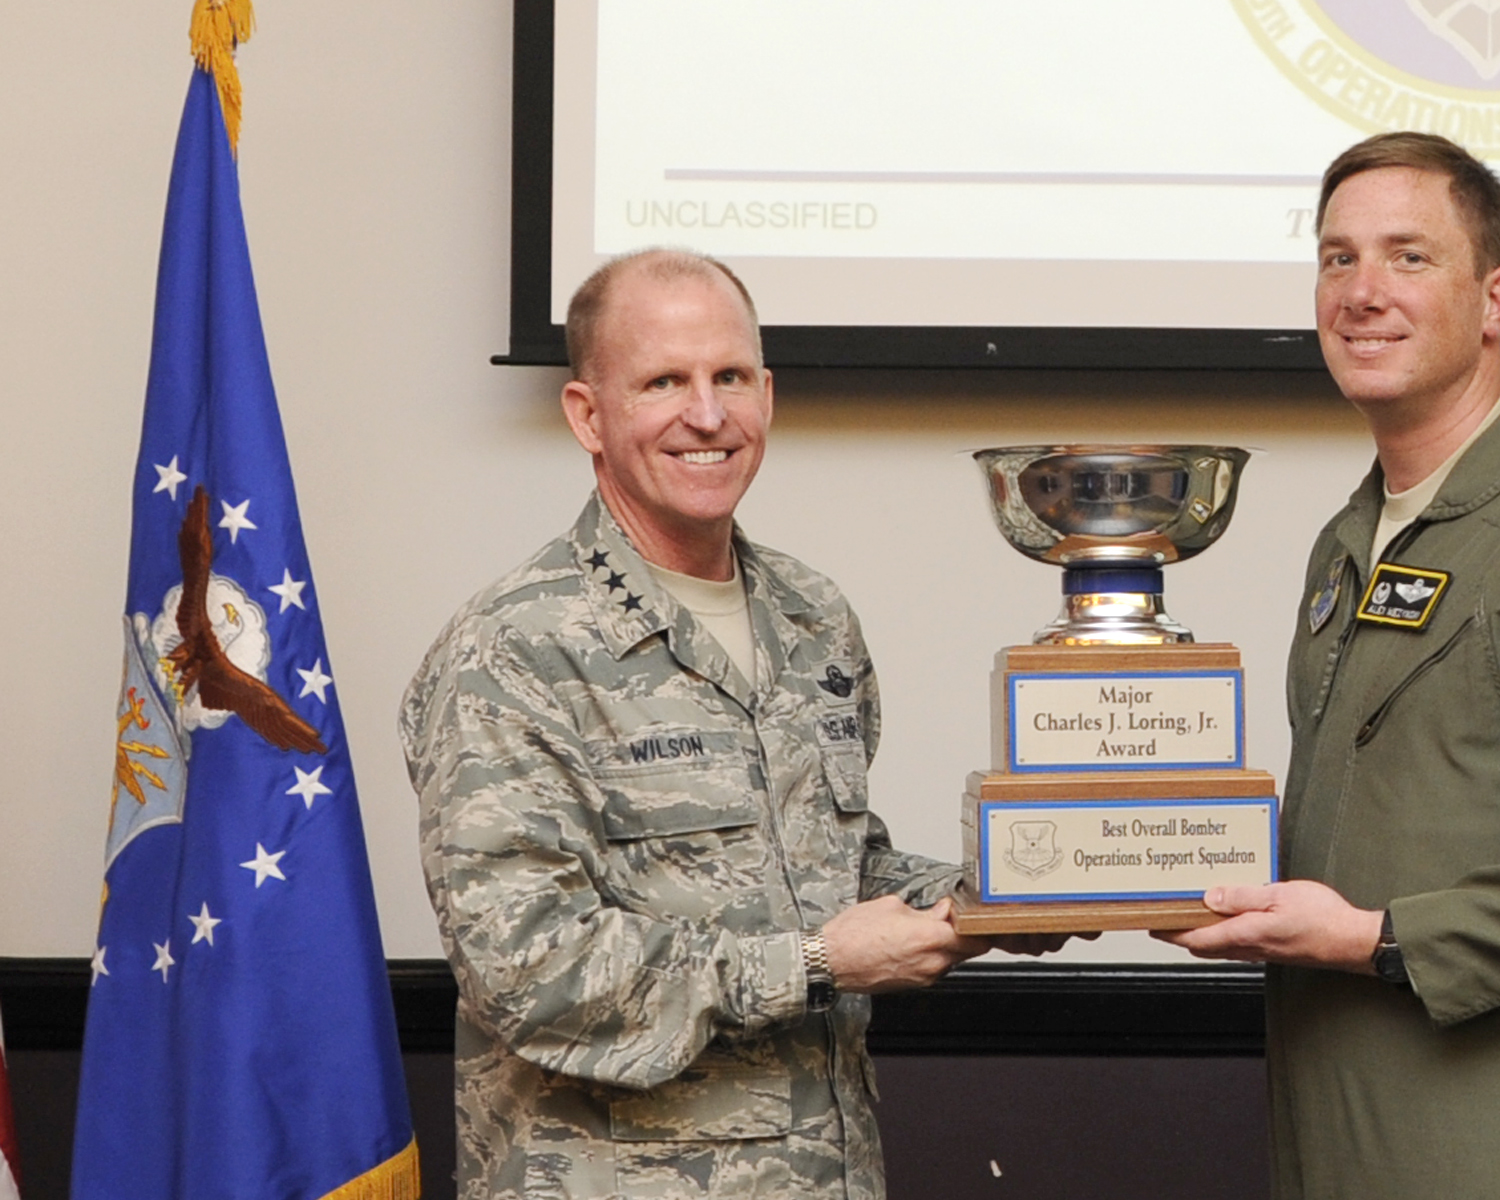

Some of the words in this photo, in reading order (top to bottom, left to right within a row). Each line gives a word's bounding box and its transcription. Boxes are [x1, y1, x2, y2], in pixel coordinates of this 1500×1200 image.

[625, 198, 879, 231] UNCLASSIFIED
[1098, 685, 1154, 710] Major
[1033, 712, 1103, 732] Charles
[1107, 713, 1122, 735] J.
[1128, 711, 1192, 735] Loring,
[1197, 711, 1218, 735] Jr.
[630, 735, 705, 763] WILSON
[1096, 738, 1157, 757] Award
[1102, 819, 1128, 838] Best
[1131, 818, 1177, 838] Overall
[1180, 817, 1227, 837] Bomber
[1072, 848, 1142, 872] Operations
[1145, 846, 1196, 872] Support
[1197, 846, 1256, 872] Squadron
